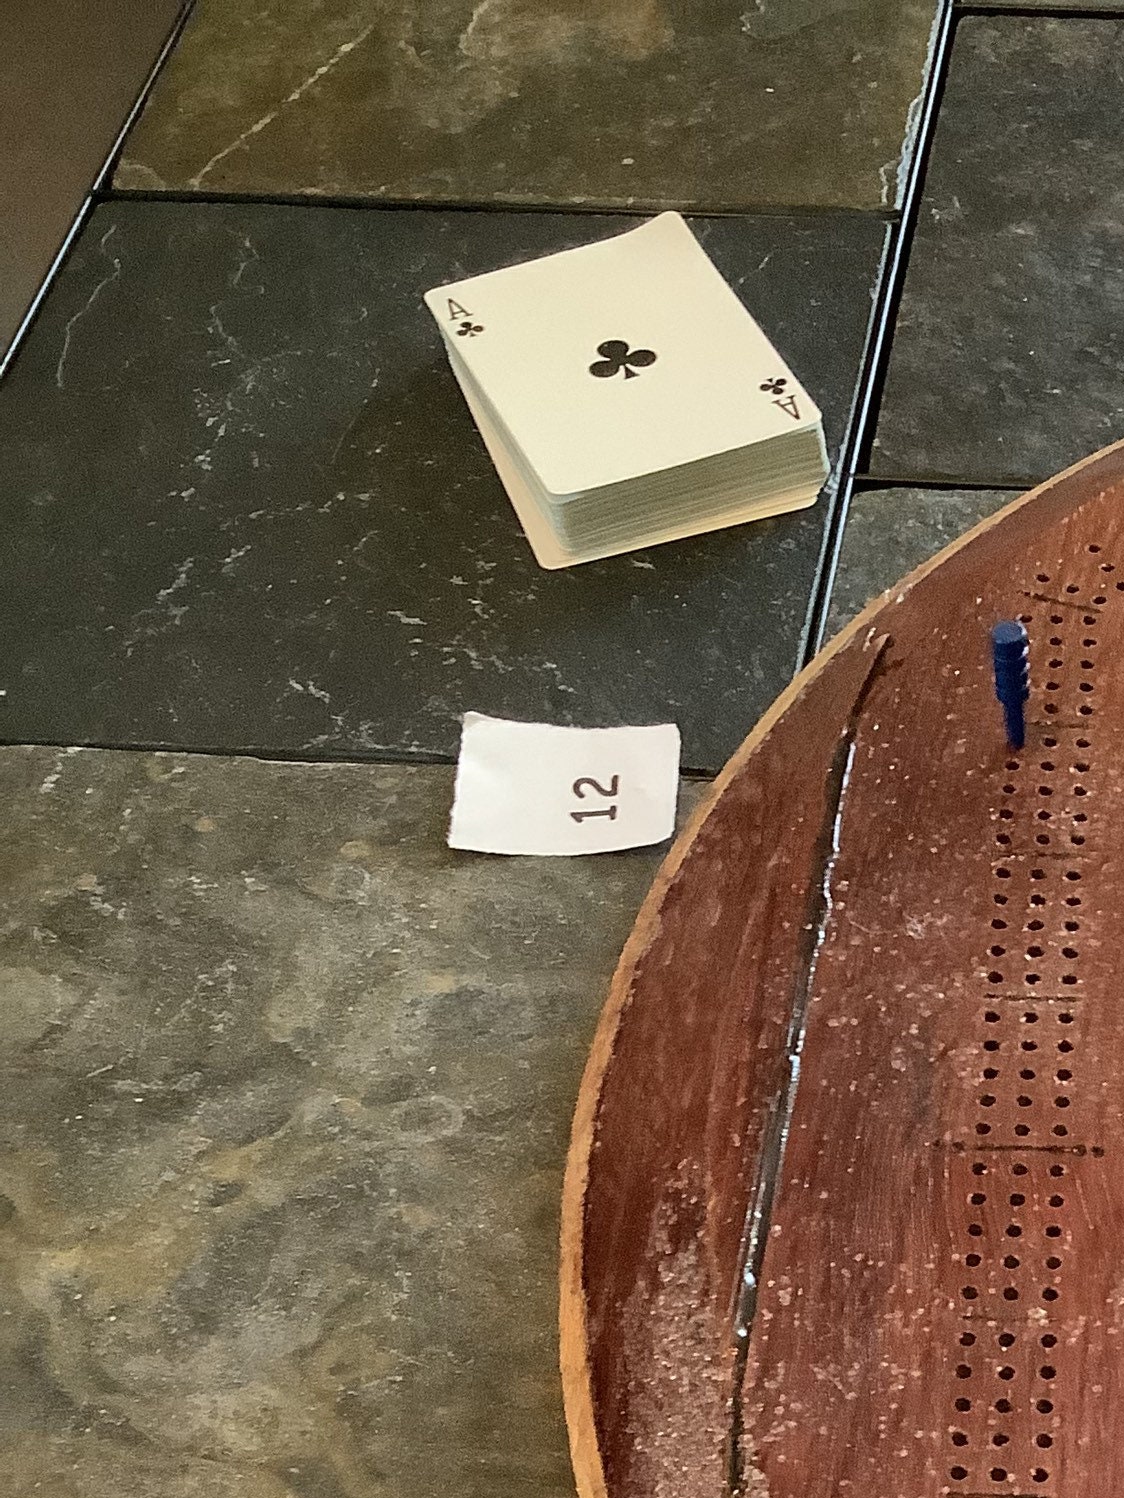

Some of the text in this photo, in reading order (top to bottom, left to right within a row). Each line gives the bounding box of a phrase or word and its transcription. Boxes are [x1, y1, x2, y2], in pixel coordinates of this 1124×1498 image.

[446, 298, 474, 320] A
[771, 394, 802, 420] A
[570, 774, 619, 823] 12
